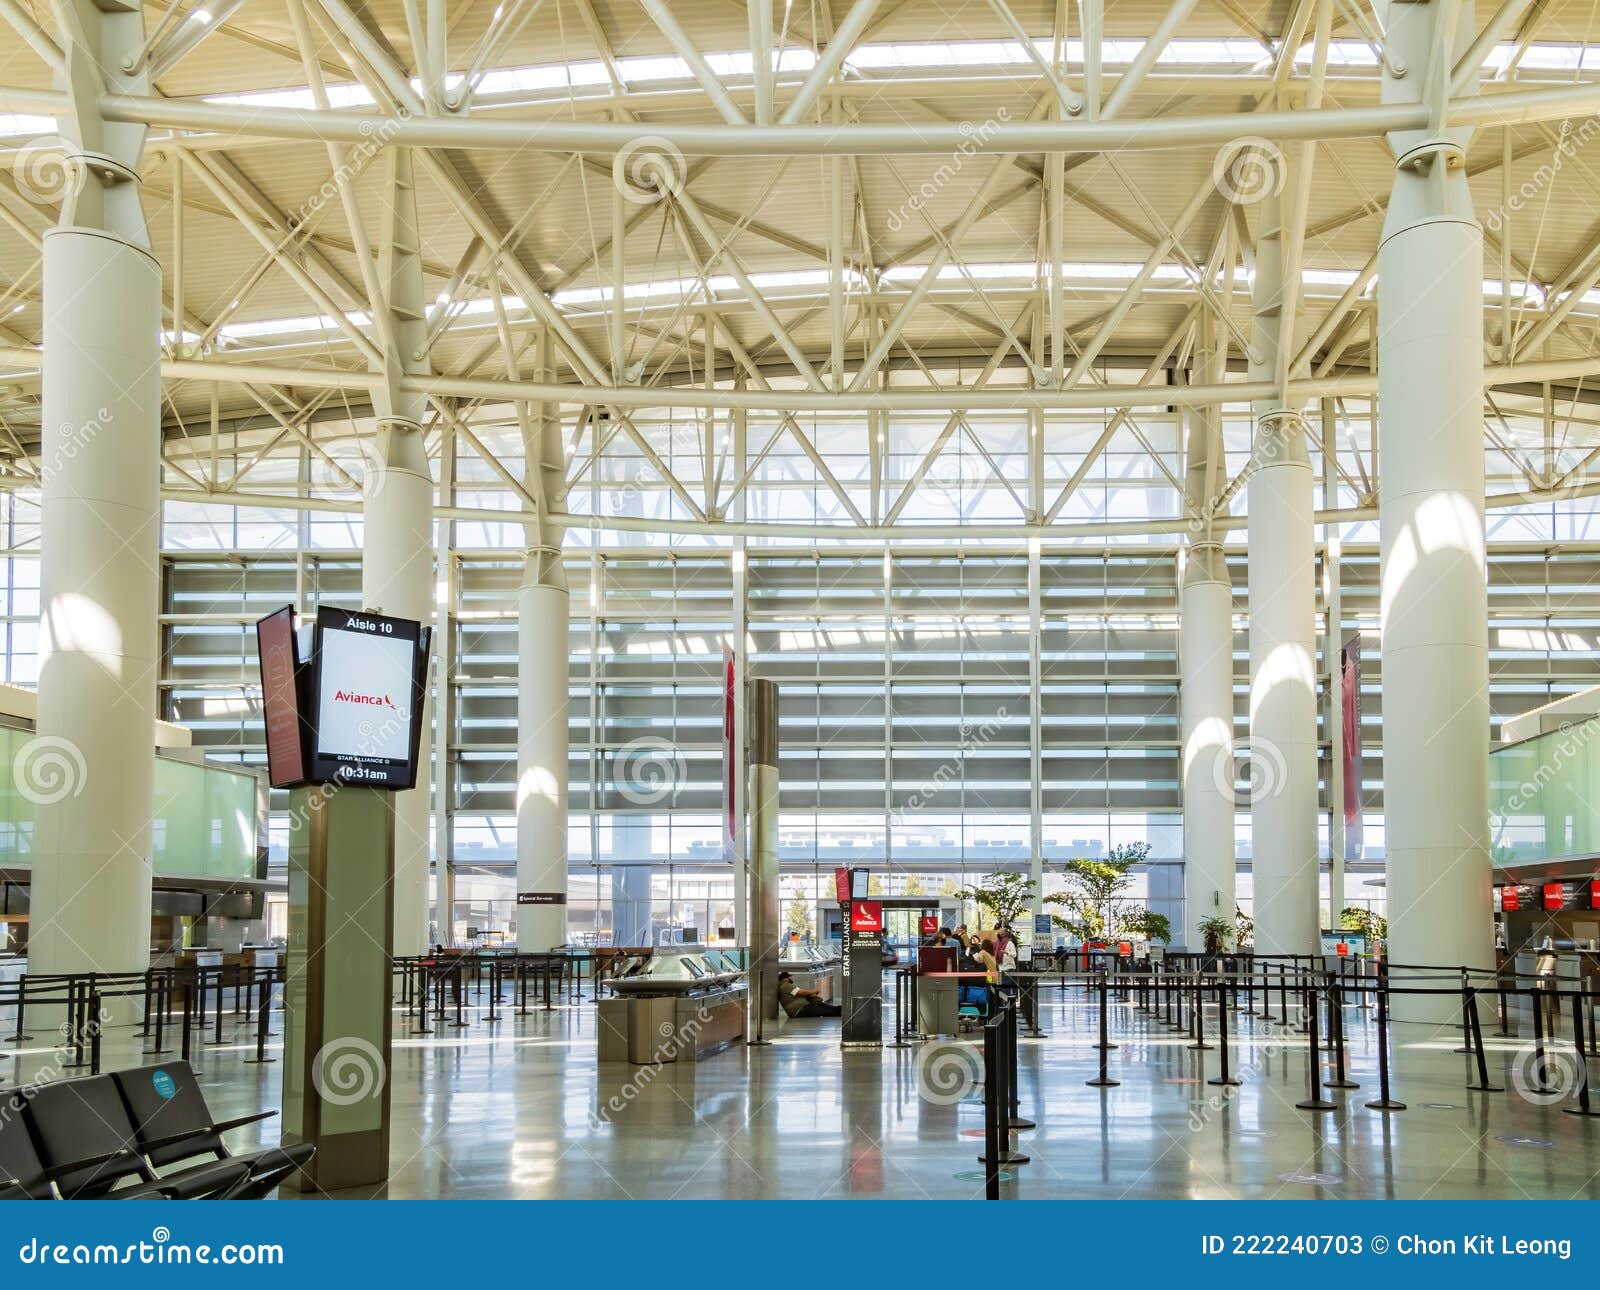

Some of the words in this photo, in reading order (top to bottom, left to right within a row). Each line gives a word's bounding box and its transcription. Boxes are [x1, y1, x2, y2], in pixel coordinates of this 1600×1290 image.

[347, 617, 376, 632] Aisle
[379, 622, 393, 634] 10
[335, 689, 383, 706] Avianca
[340, 766, 388, 780] 10:31am
